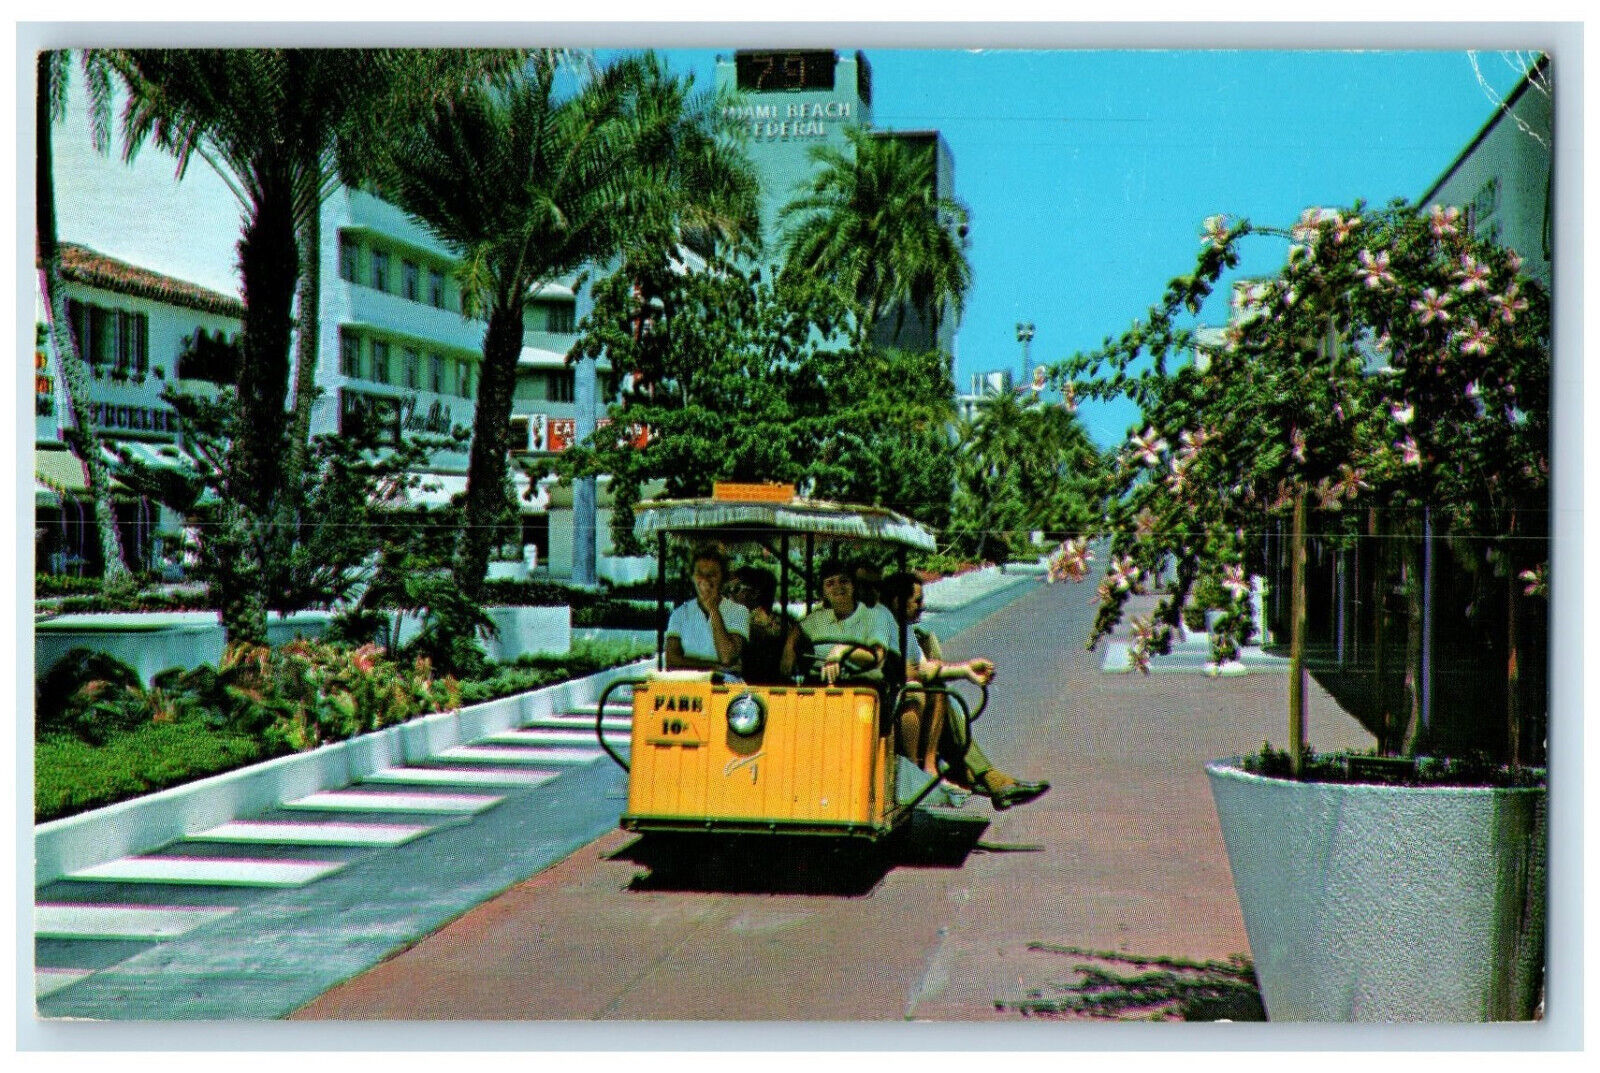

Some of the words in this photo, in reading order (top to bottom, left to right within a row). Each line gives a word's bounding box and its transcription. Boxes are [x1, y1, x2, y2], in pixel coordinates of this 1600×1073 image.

[722, 104, 777, 119] MIAMI
[787, 102, 851, 119] BEACH
[742, 120, 827, 137] EDERAL
